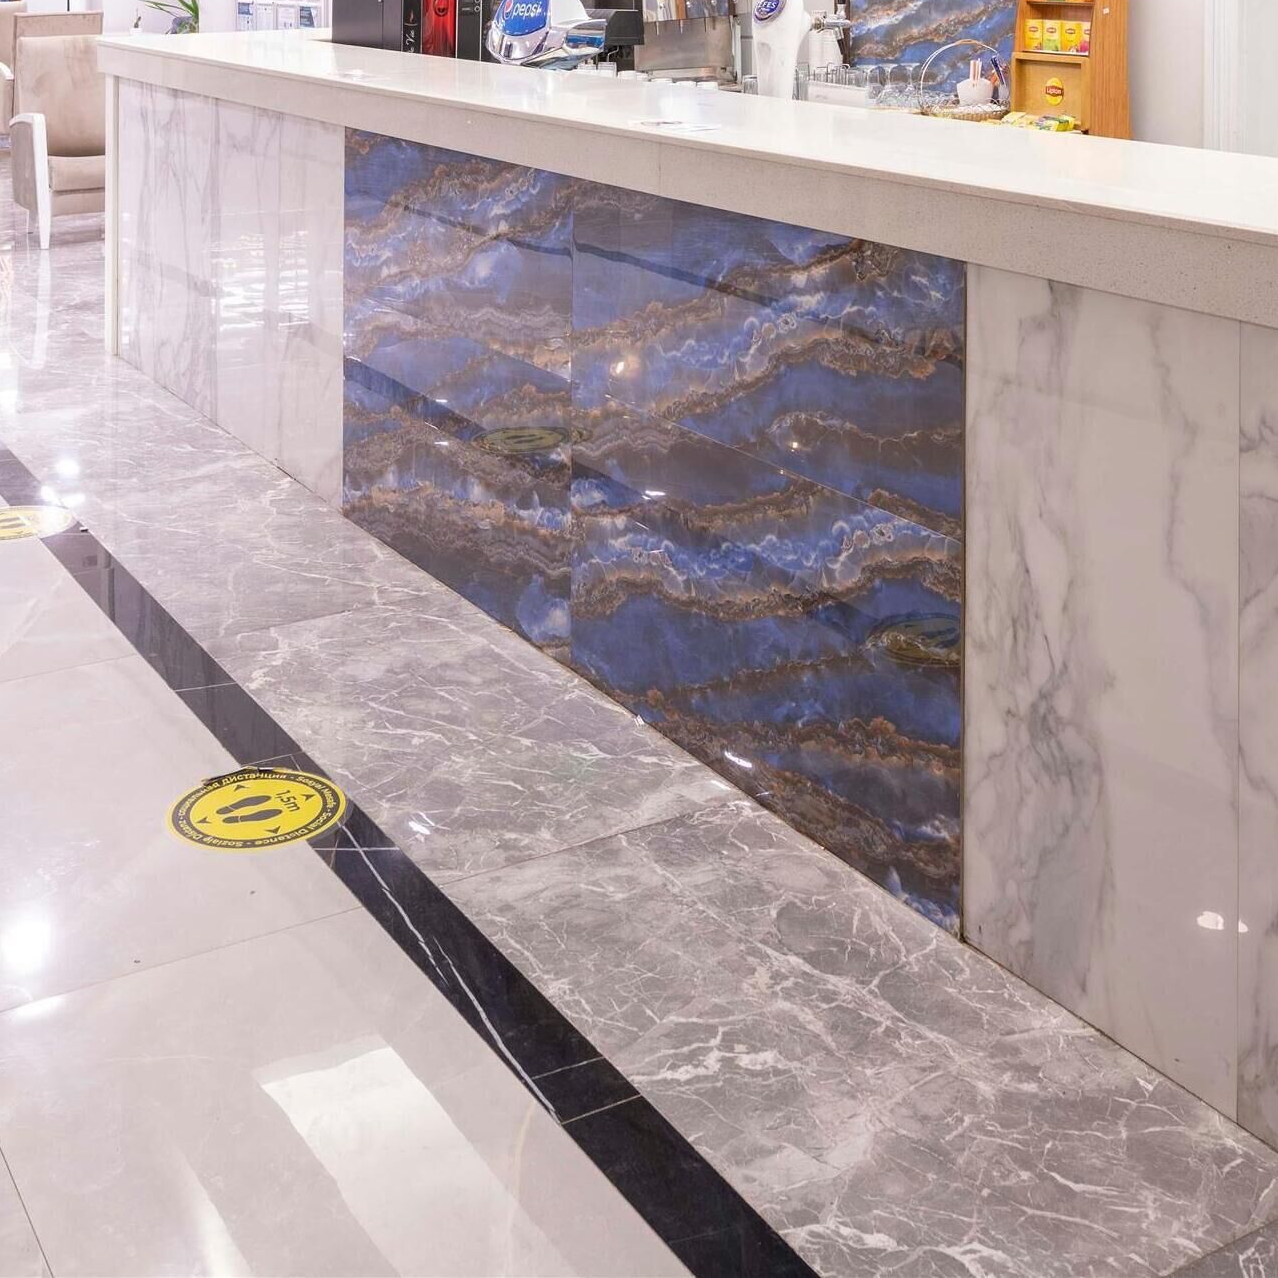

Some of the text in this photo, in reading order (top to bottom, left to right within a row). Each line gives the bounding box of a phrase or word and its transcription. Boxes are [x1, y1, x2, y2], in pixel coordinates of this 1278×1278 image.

[511, 1, 542, 21] pepsi
[254, 811, 332, 845] Social Distance
